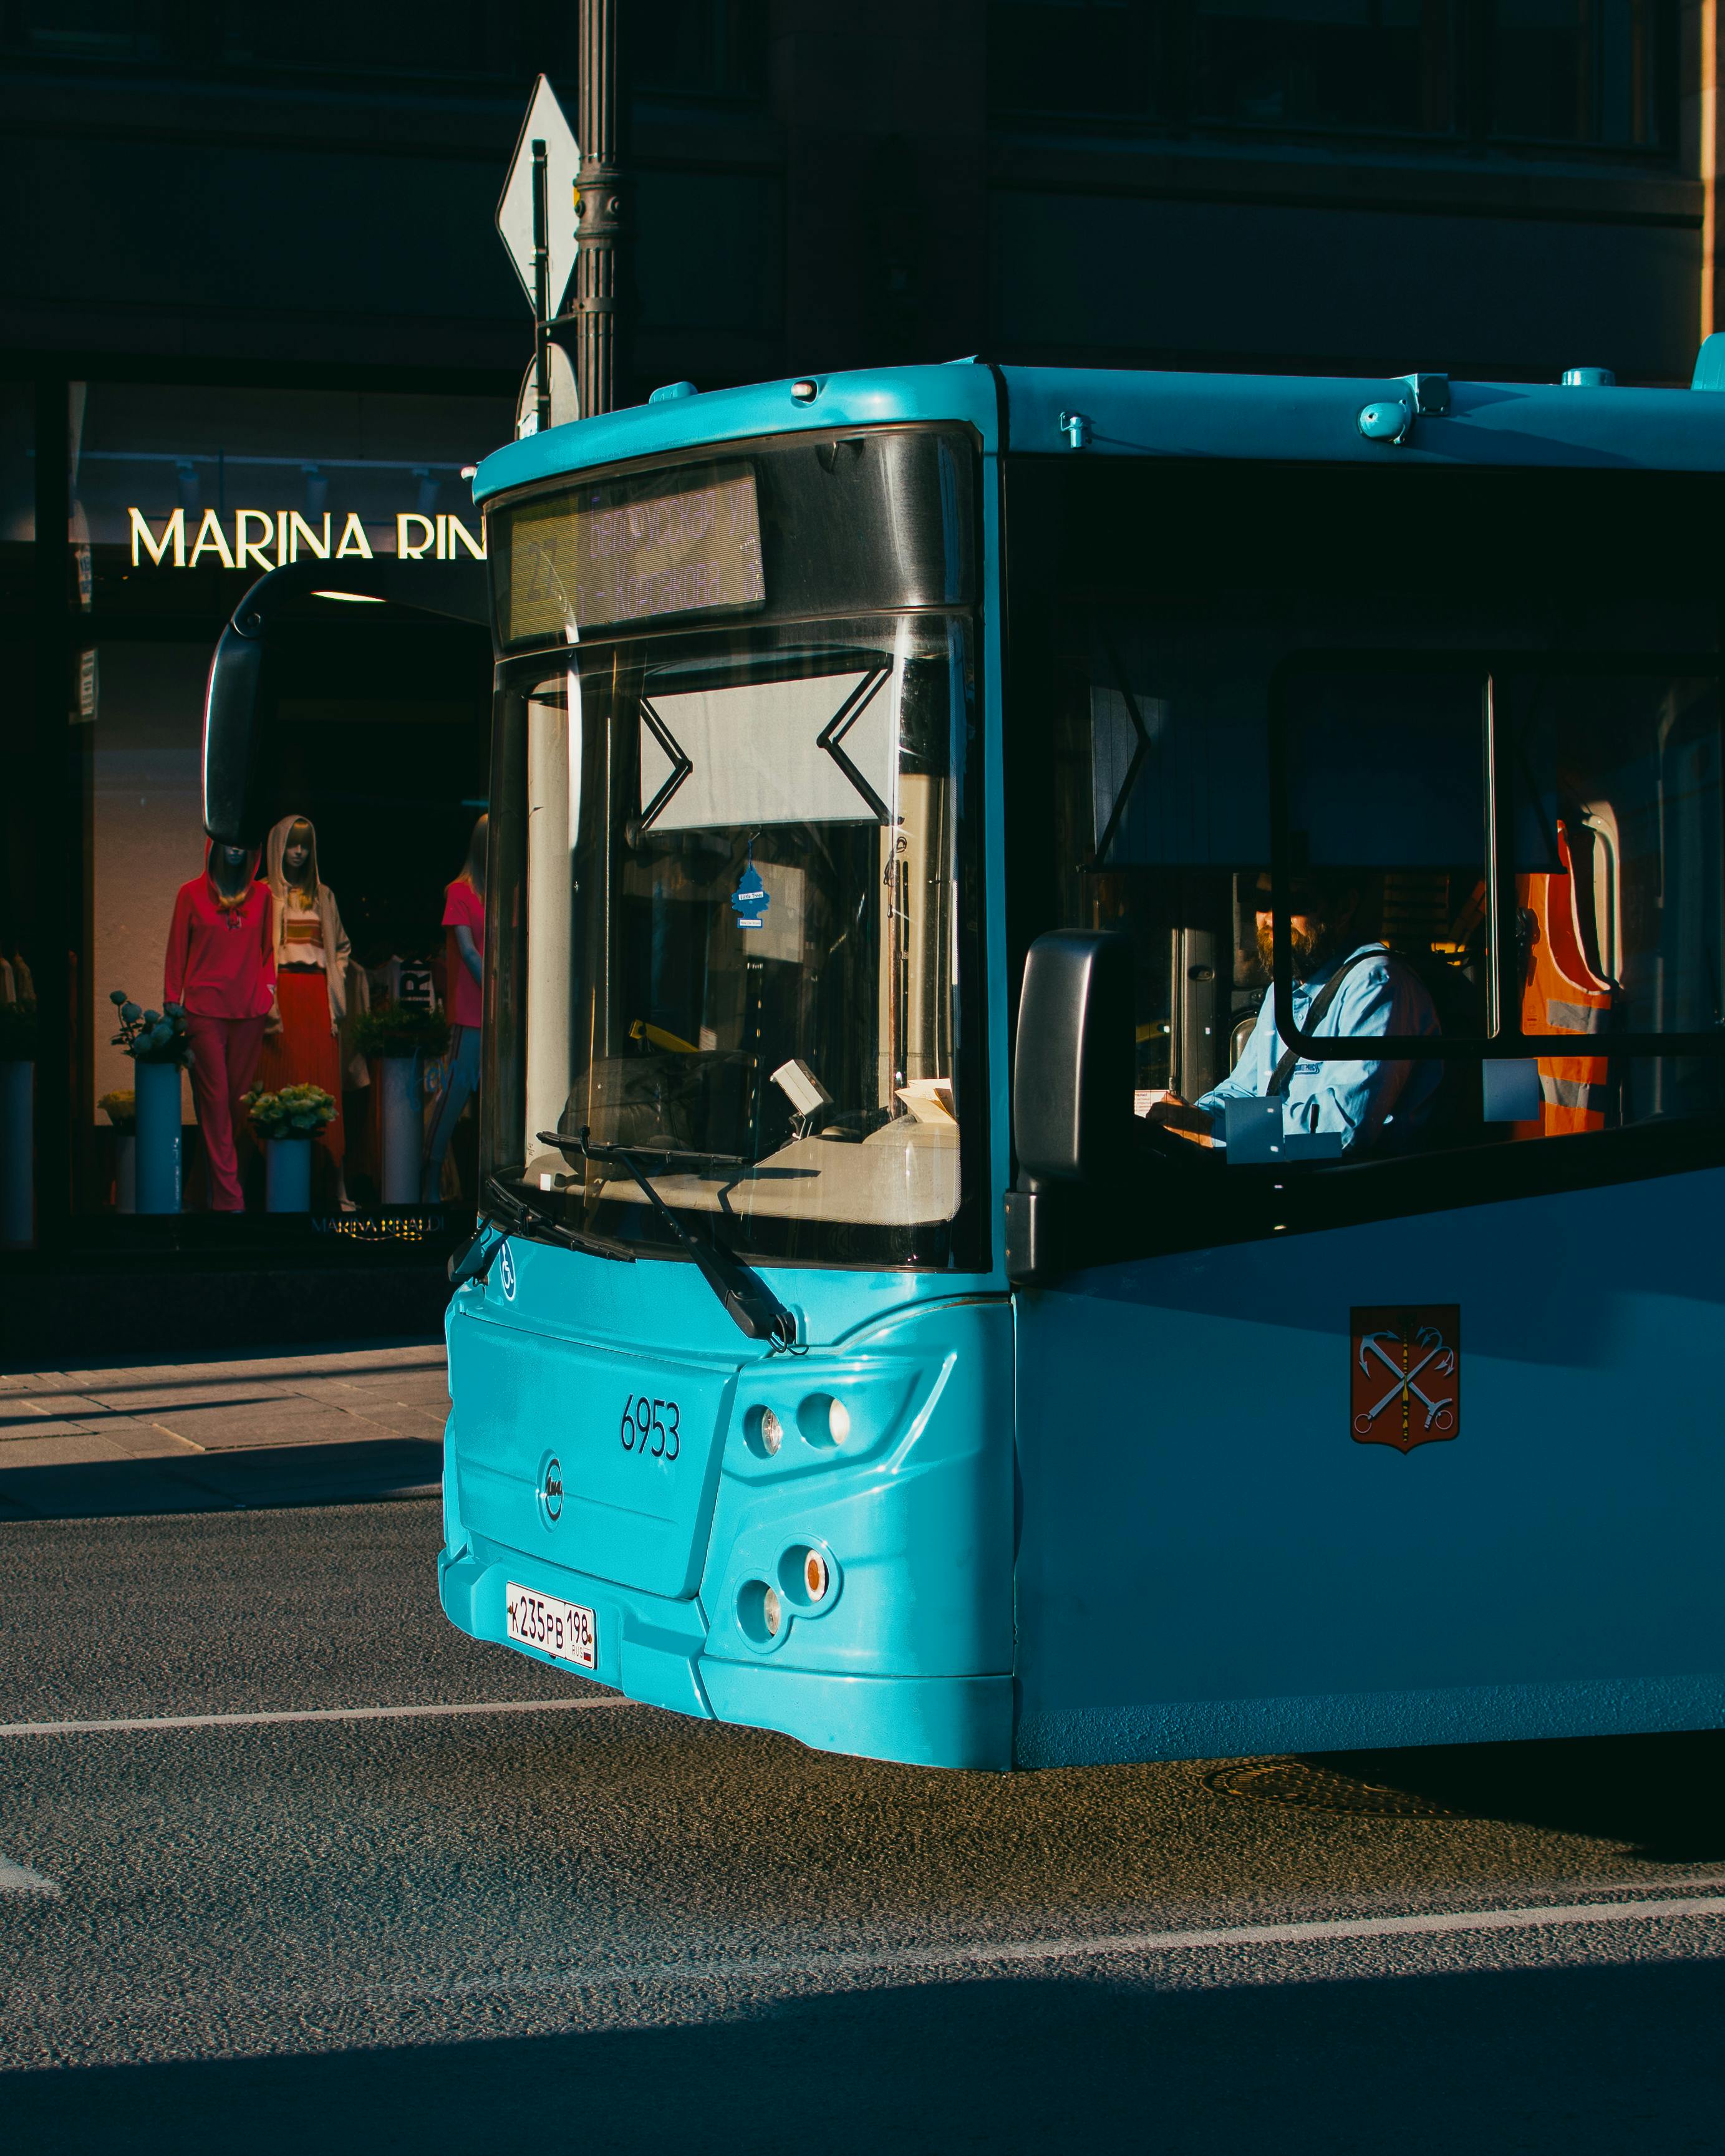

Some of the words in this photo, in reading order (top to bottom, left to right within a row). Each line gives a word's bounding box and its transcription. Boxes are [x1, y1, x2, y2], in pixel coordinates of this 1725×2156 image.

[128, 507, 374, 572] MARINA
[311, 1217, 377, 1233] MARINA
[621, 1393, 680, 1461] 6953
[566, 1610, 588, 1646] 198
[572, 1645, 583, 1658] RUS
